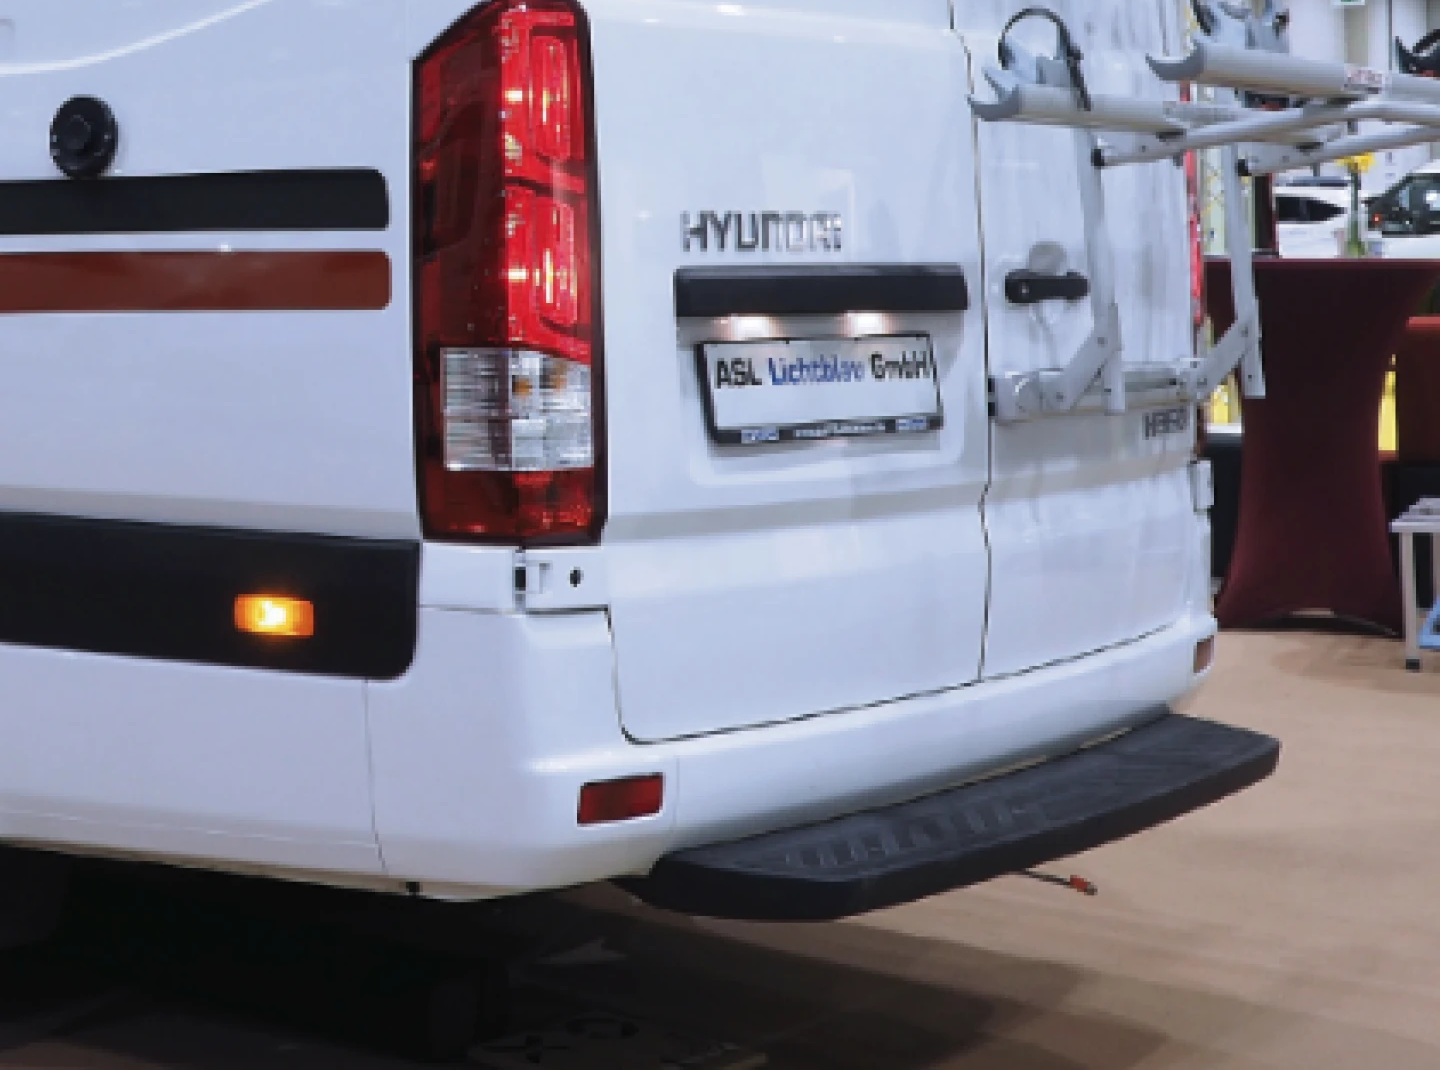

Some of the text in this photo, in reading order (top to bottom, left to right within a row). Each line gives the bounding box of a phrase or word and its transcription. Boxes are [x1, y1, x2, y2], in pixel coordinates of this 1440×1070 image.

[680, 210, 841, 252] HYUNDAI
[715, 357, 763, 388] ASL
[868, 350, 931, 381] GmbH
